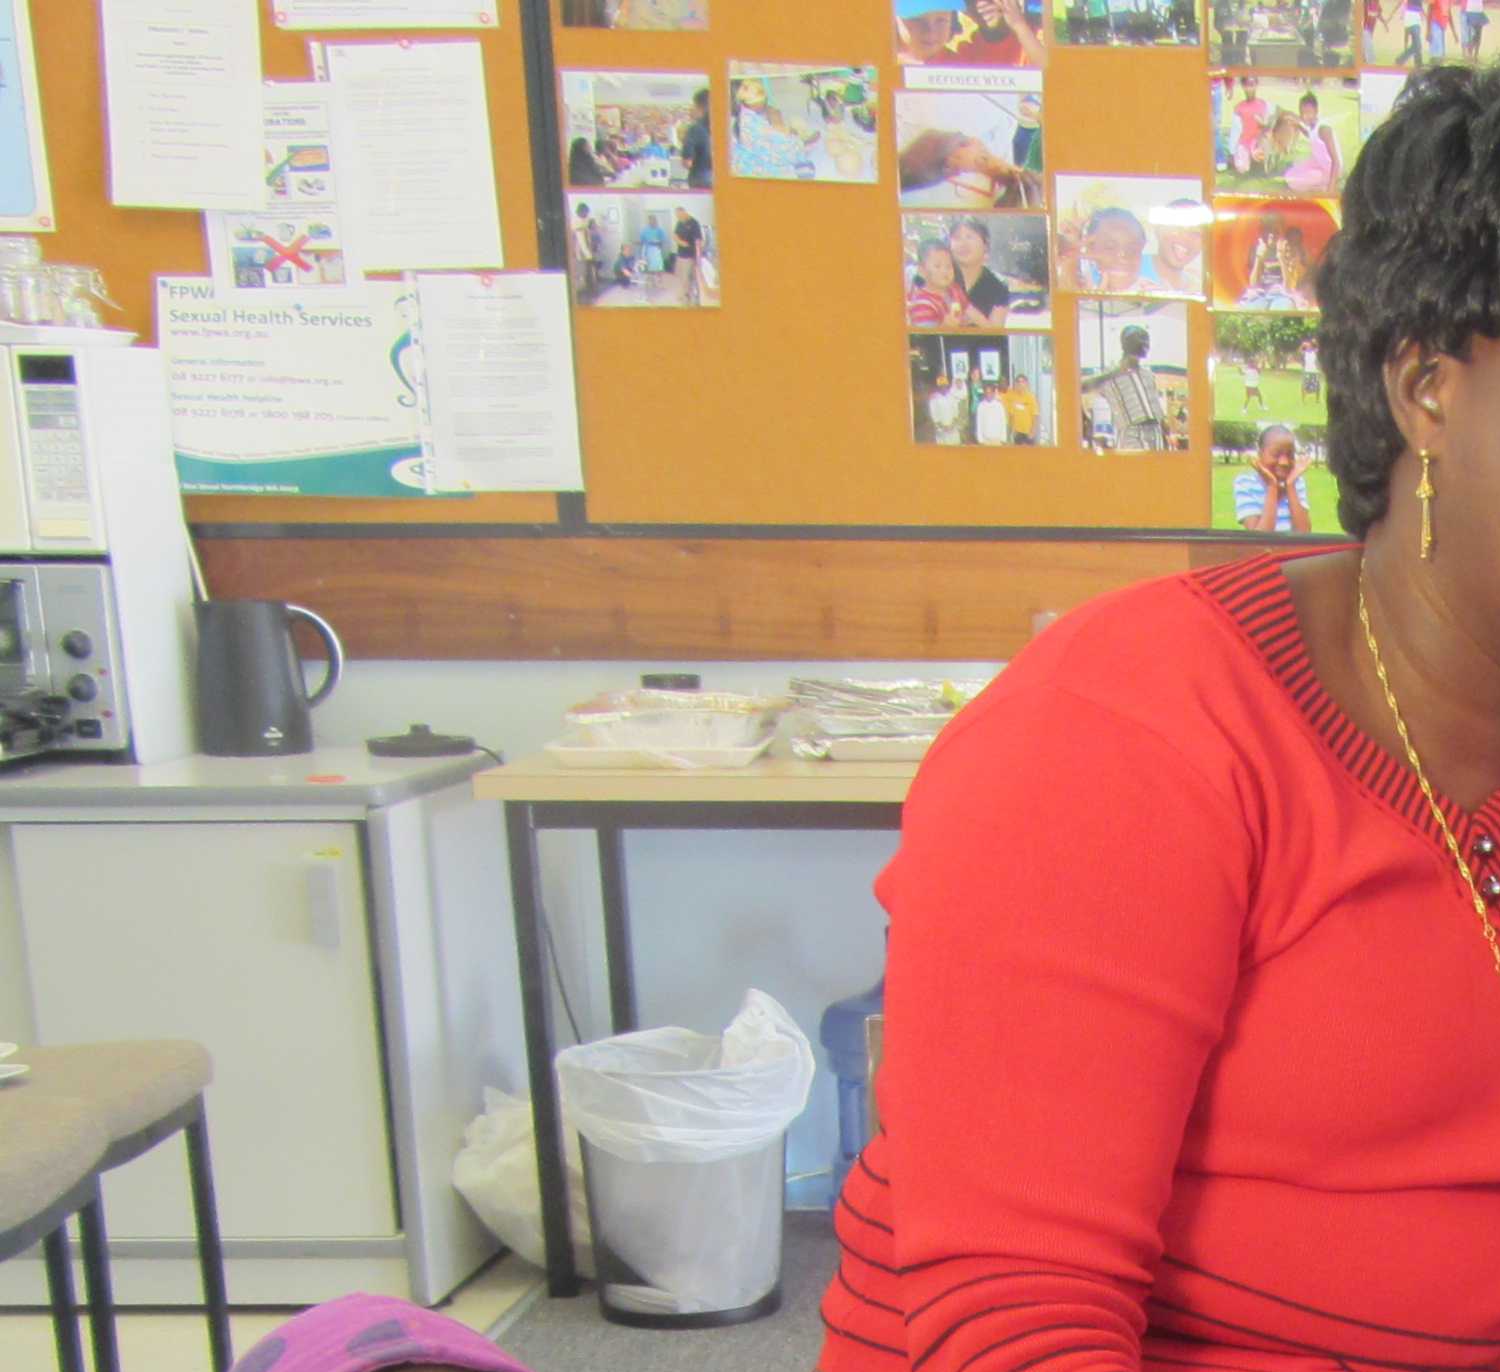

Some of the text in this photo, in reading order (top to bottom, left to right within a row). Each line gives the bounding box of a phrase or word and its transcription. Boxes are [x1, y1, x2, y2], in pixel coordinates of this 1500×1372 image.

[169, 309, 373, 328] Sexual Health Services
